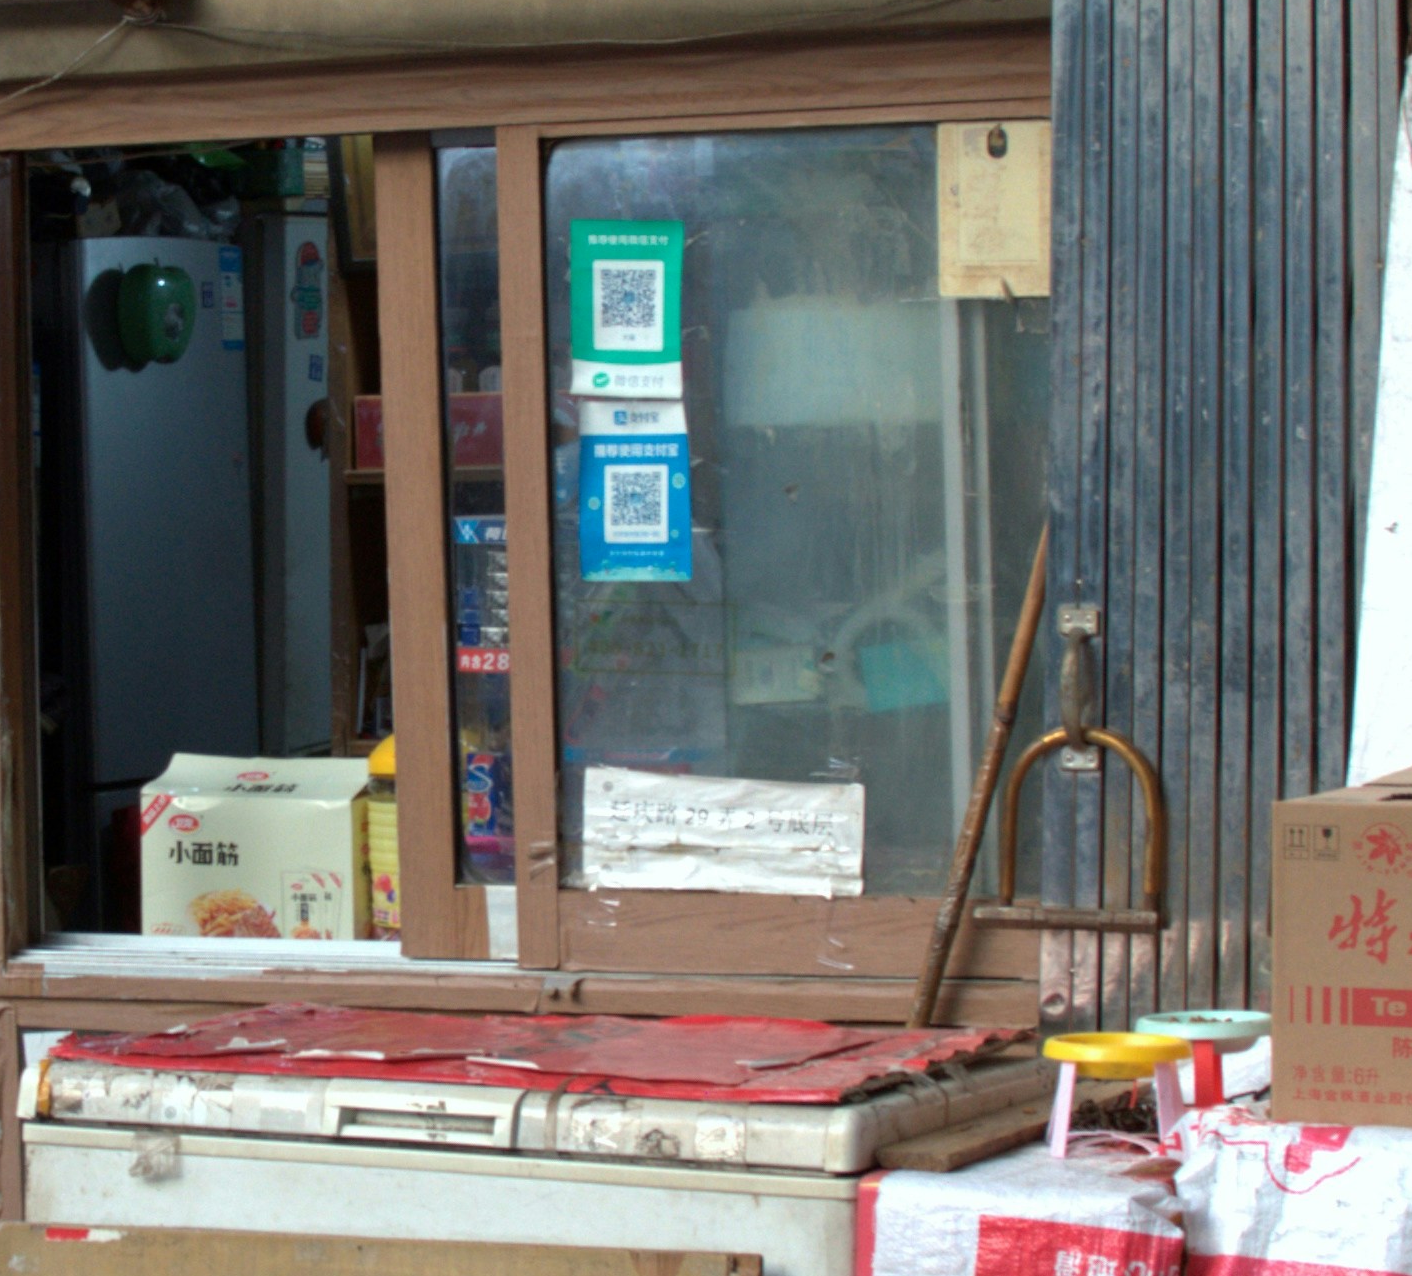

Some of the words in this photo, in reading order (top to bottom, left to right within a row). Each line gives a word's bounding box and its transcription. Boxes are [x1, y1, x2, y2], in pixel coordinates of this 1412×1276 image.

[169, 841, 239, 866] 小面筋
[1370, 995, 1407, 1017] Te
